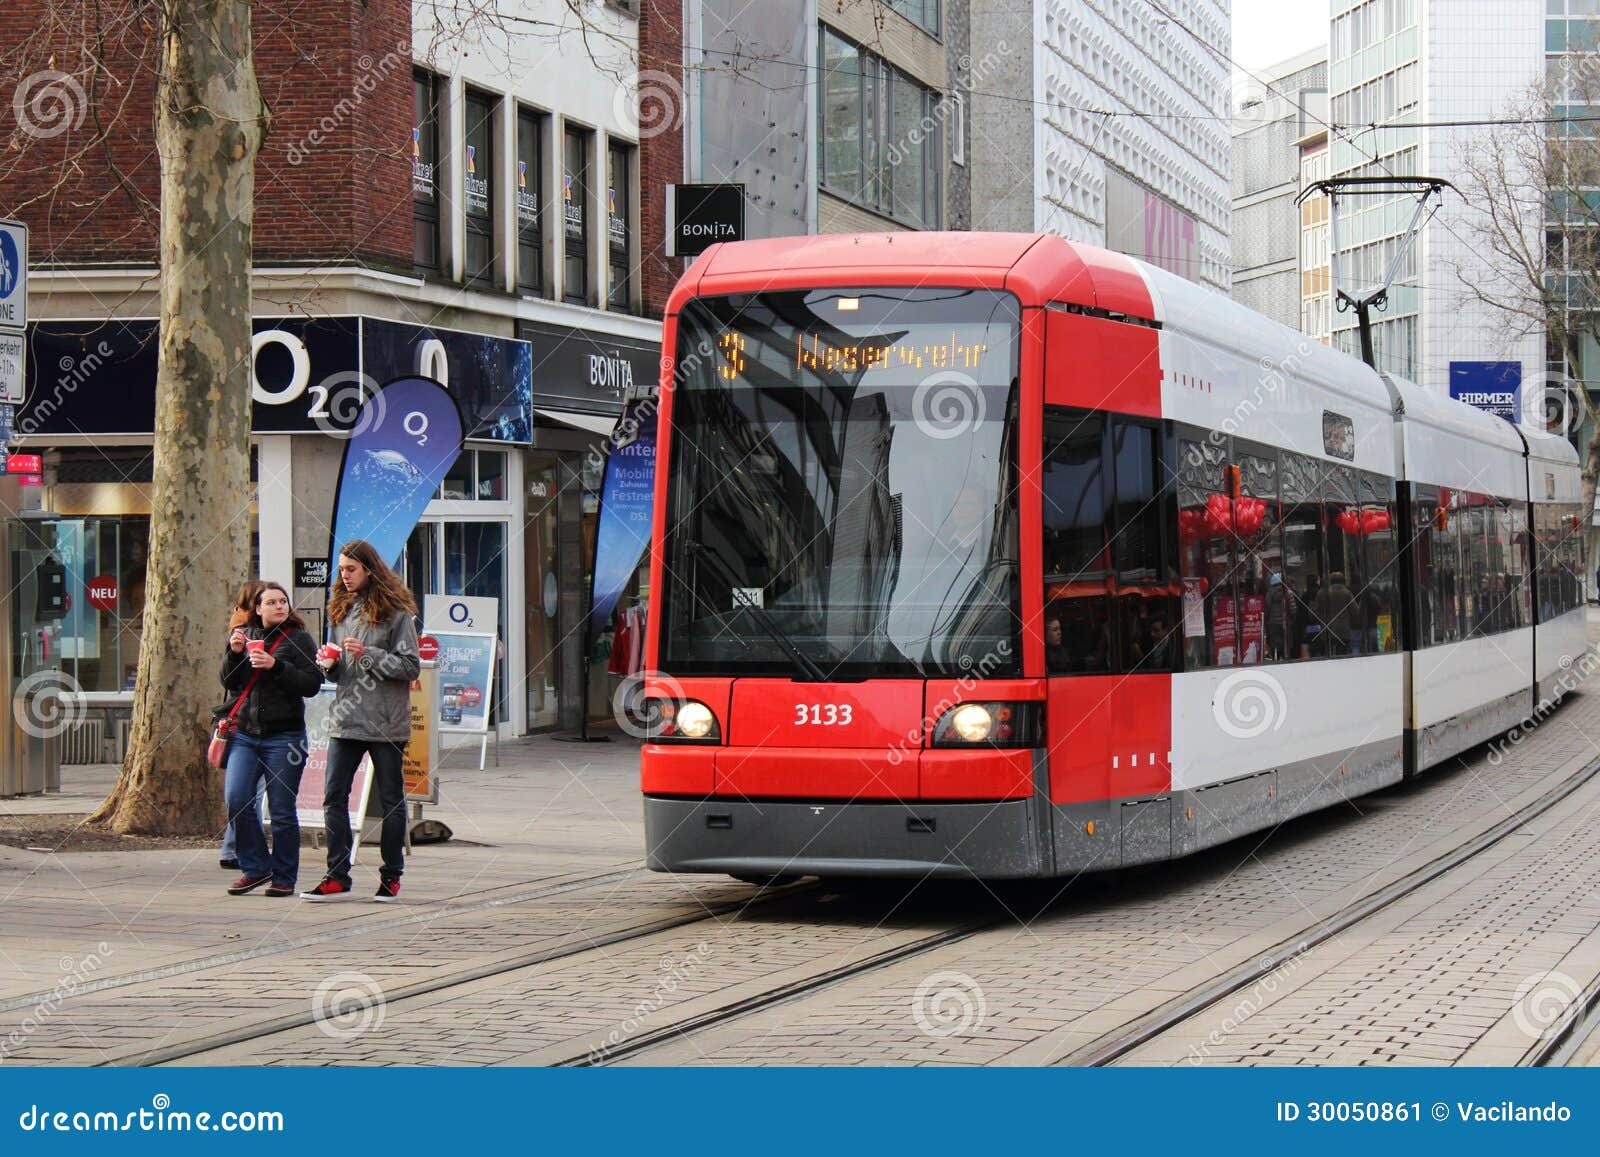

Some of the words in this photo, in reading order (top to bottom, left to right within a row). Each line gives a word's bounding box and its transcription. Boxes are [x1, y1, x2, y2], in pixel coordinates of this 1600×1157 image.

[0, 303, 15, 320] NE
[717, 333, 745, 380] 3
[1458, 393, 1514, 404] HIRMER
[91, 588, 117, 599] NEU
[794, 703, 853, 726] 3133
